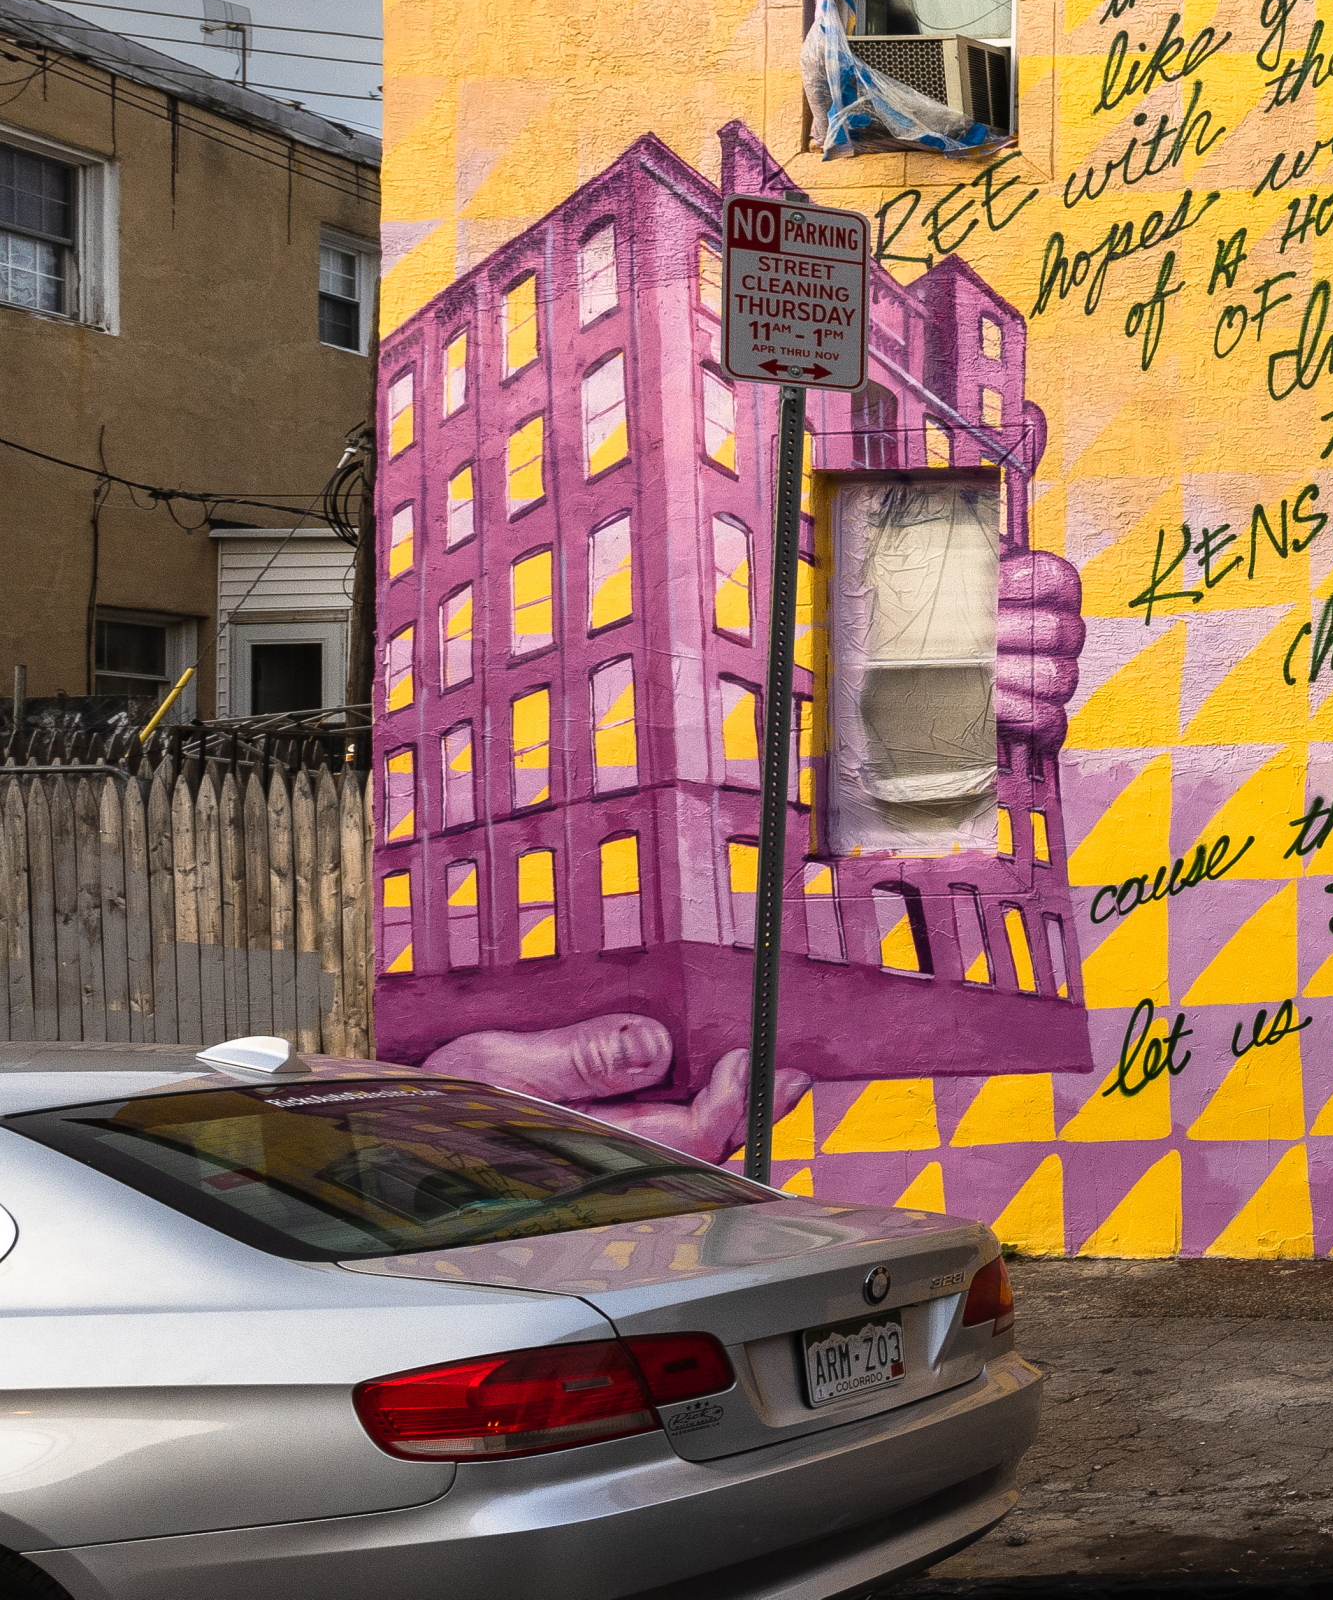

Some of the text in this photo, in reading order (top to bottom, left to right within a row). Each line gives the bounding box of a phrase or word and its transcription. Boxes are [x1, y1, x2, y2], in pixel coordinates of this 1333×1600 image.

[1092, 13, 1232, 116] like
[874, 149, 1040, 271] REE
[1063, 79, 1226, 208] with
[733, 206, 859, 251] NO PARKING
[758, 255, 835, 280] STREET
[1030, 190, 1222, 319] hopes
[735, 293, 856, 327] THURSDAY
[741, 274, 850, 303] CLEANING
[1124, 251, 1187, 370] of
[1207, 227, 1248, 295] A
[1213, 270, 1296, 358] OF
[752, 343, 840, 362] APR THRU NOV
[1090, 834, 1255, 924] cause
[1103, 997, 1194, 1097] let
[1232, 998, 1314, 1057] us
[836, 1371, 883, 1393] COLORADO
